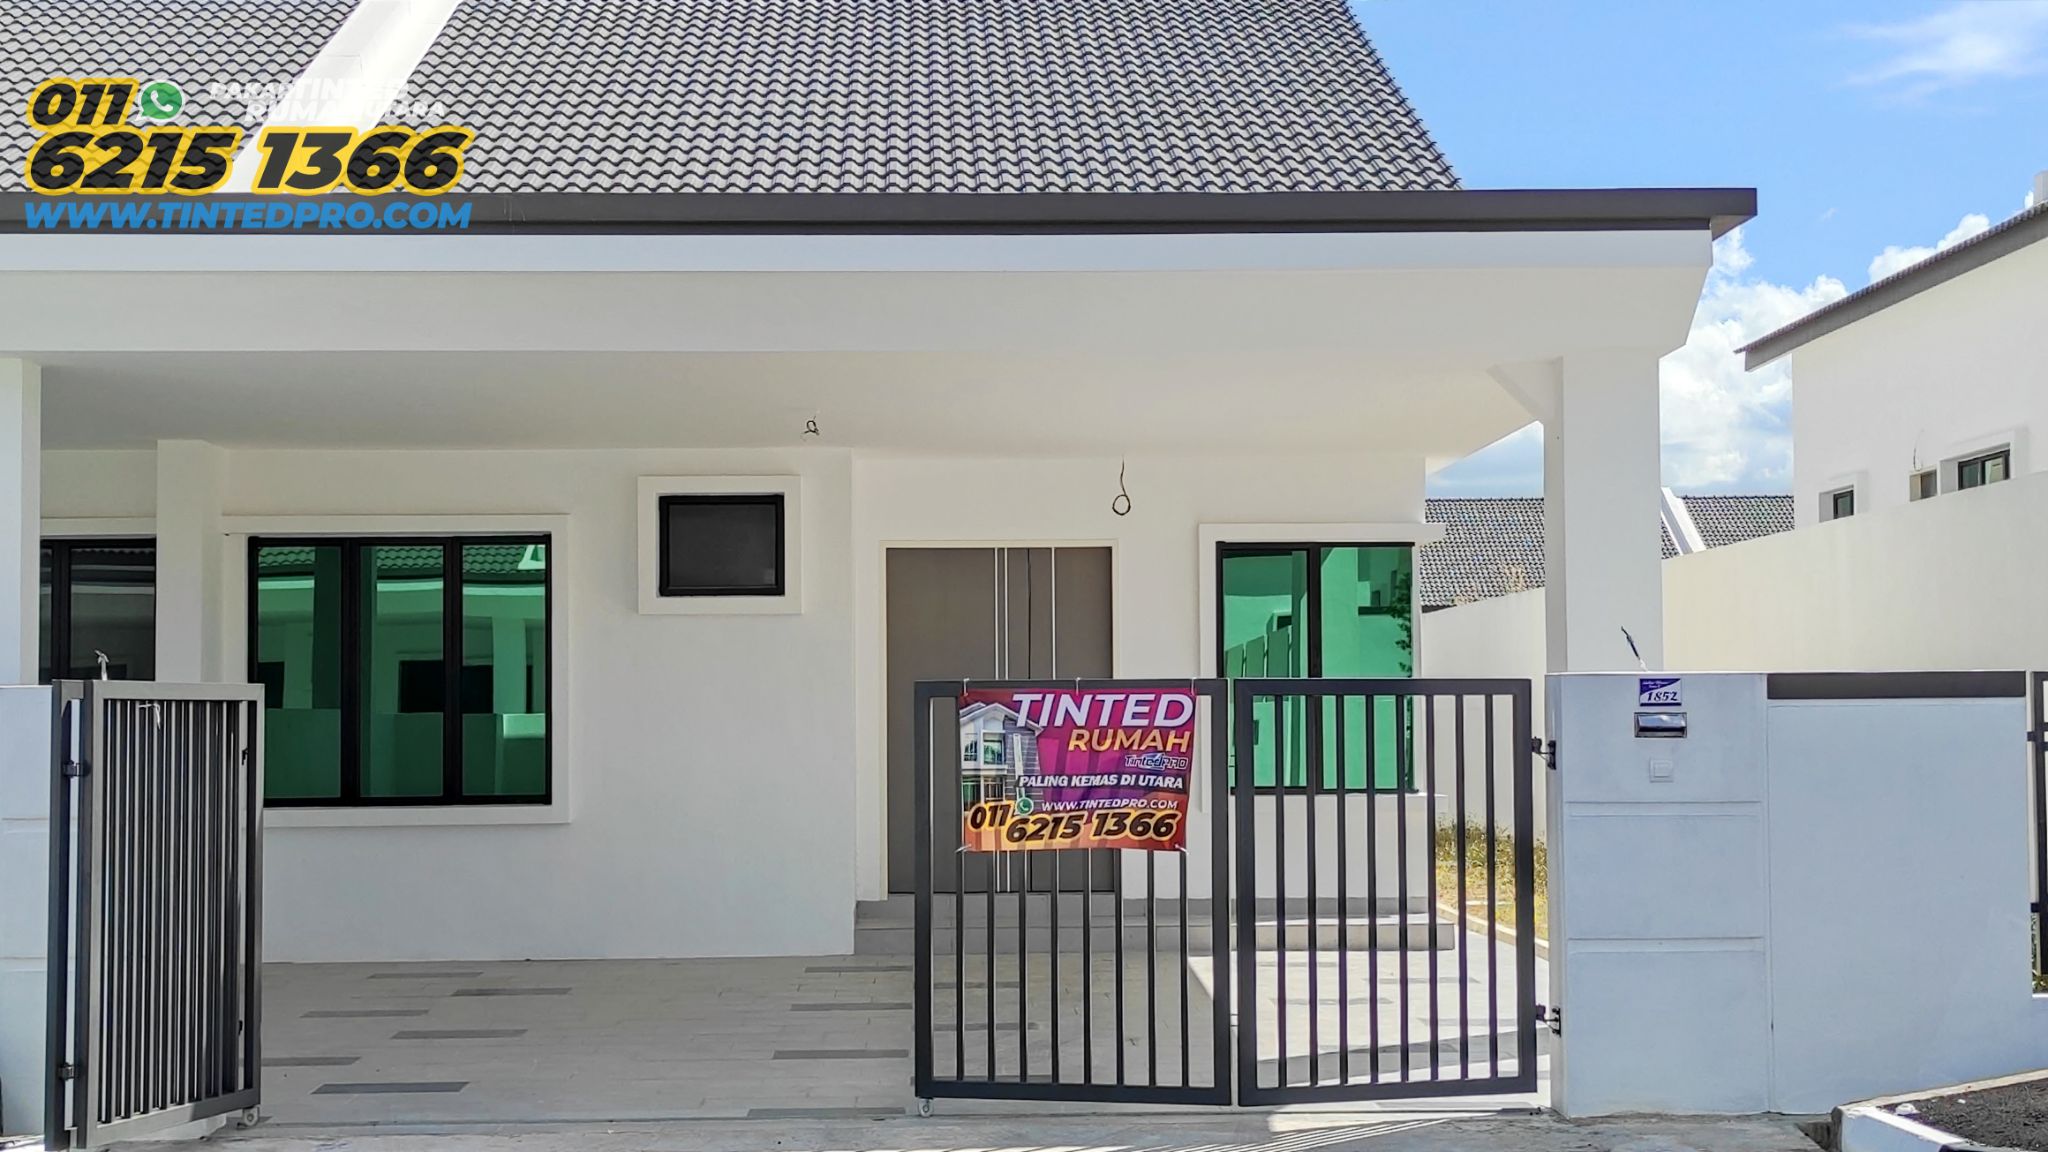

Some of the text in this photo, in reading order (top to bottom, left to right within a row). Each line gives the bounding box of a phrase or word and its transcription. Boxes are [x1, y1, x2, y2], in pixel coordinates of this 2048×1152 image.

[1647, 691, 1679, 701] 1852
[1012, 693, 1194, 728] TINTED
[1068, 729, 1192, 753] RUMAH
[1018, 774, 1183, 789] PALING KEMAS DI UTARA
[970, 804, 1011, 830] 011
[1042, 799, 1179, 811] WWW.TINTEDPRO.COM
[1006, 812, 1177, 843] 6215 1366
